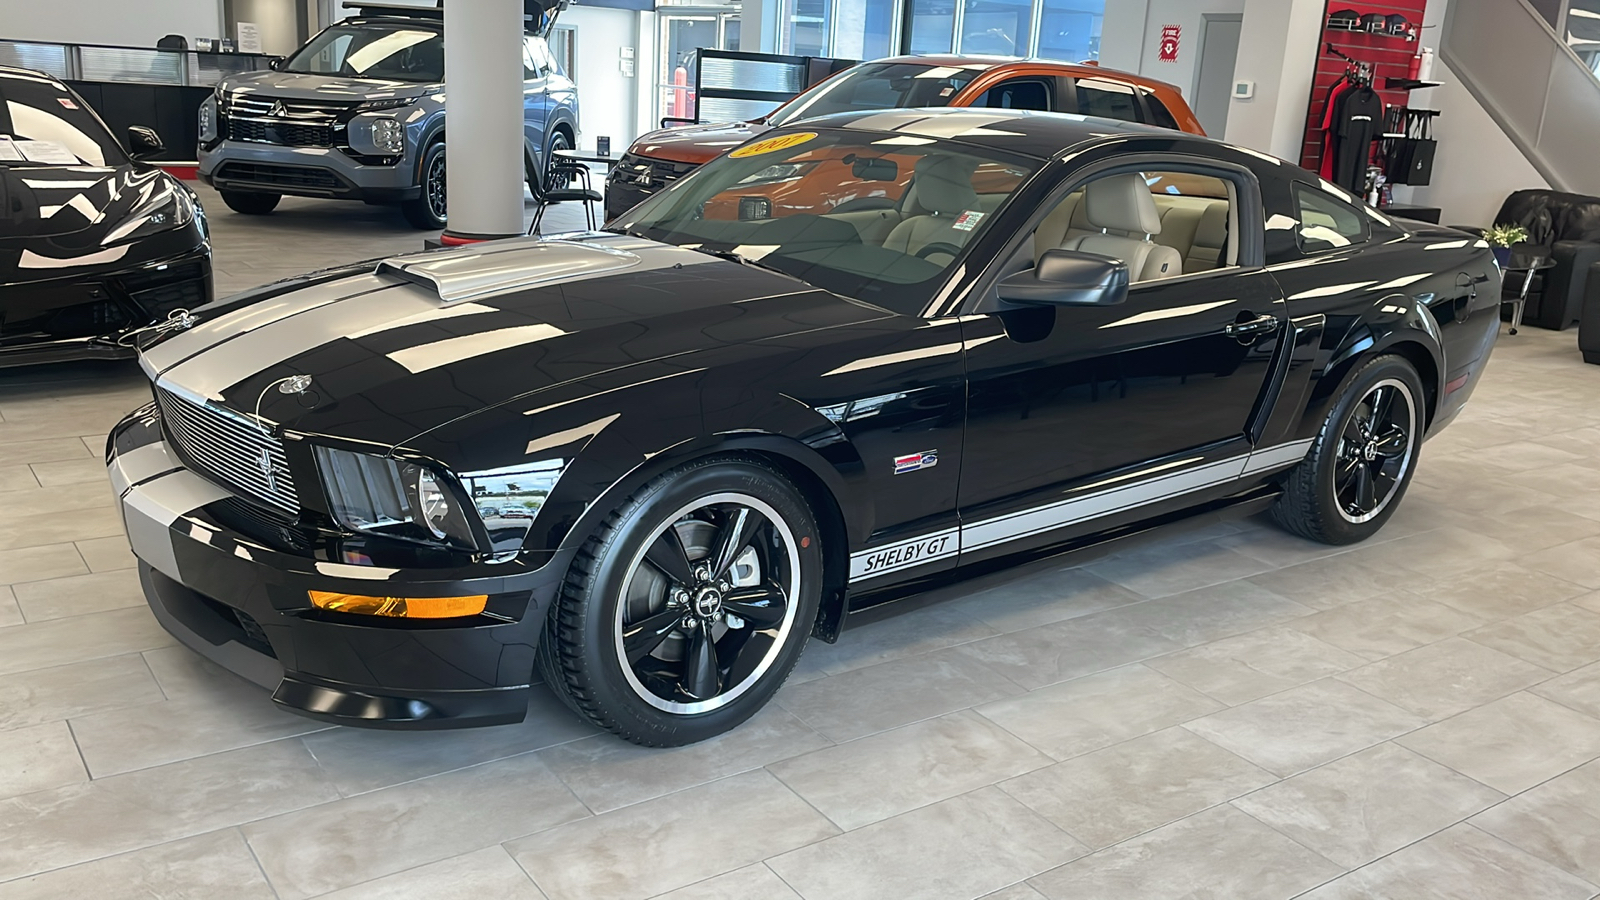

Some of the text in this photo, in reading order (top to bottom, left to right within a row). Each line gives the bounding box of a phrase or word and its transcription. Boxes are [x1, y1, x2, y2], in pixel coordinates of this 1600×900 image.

[738, 135, 805, 156] 2007
[864, 537, 949, 571] SHELBY GT
